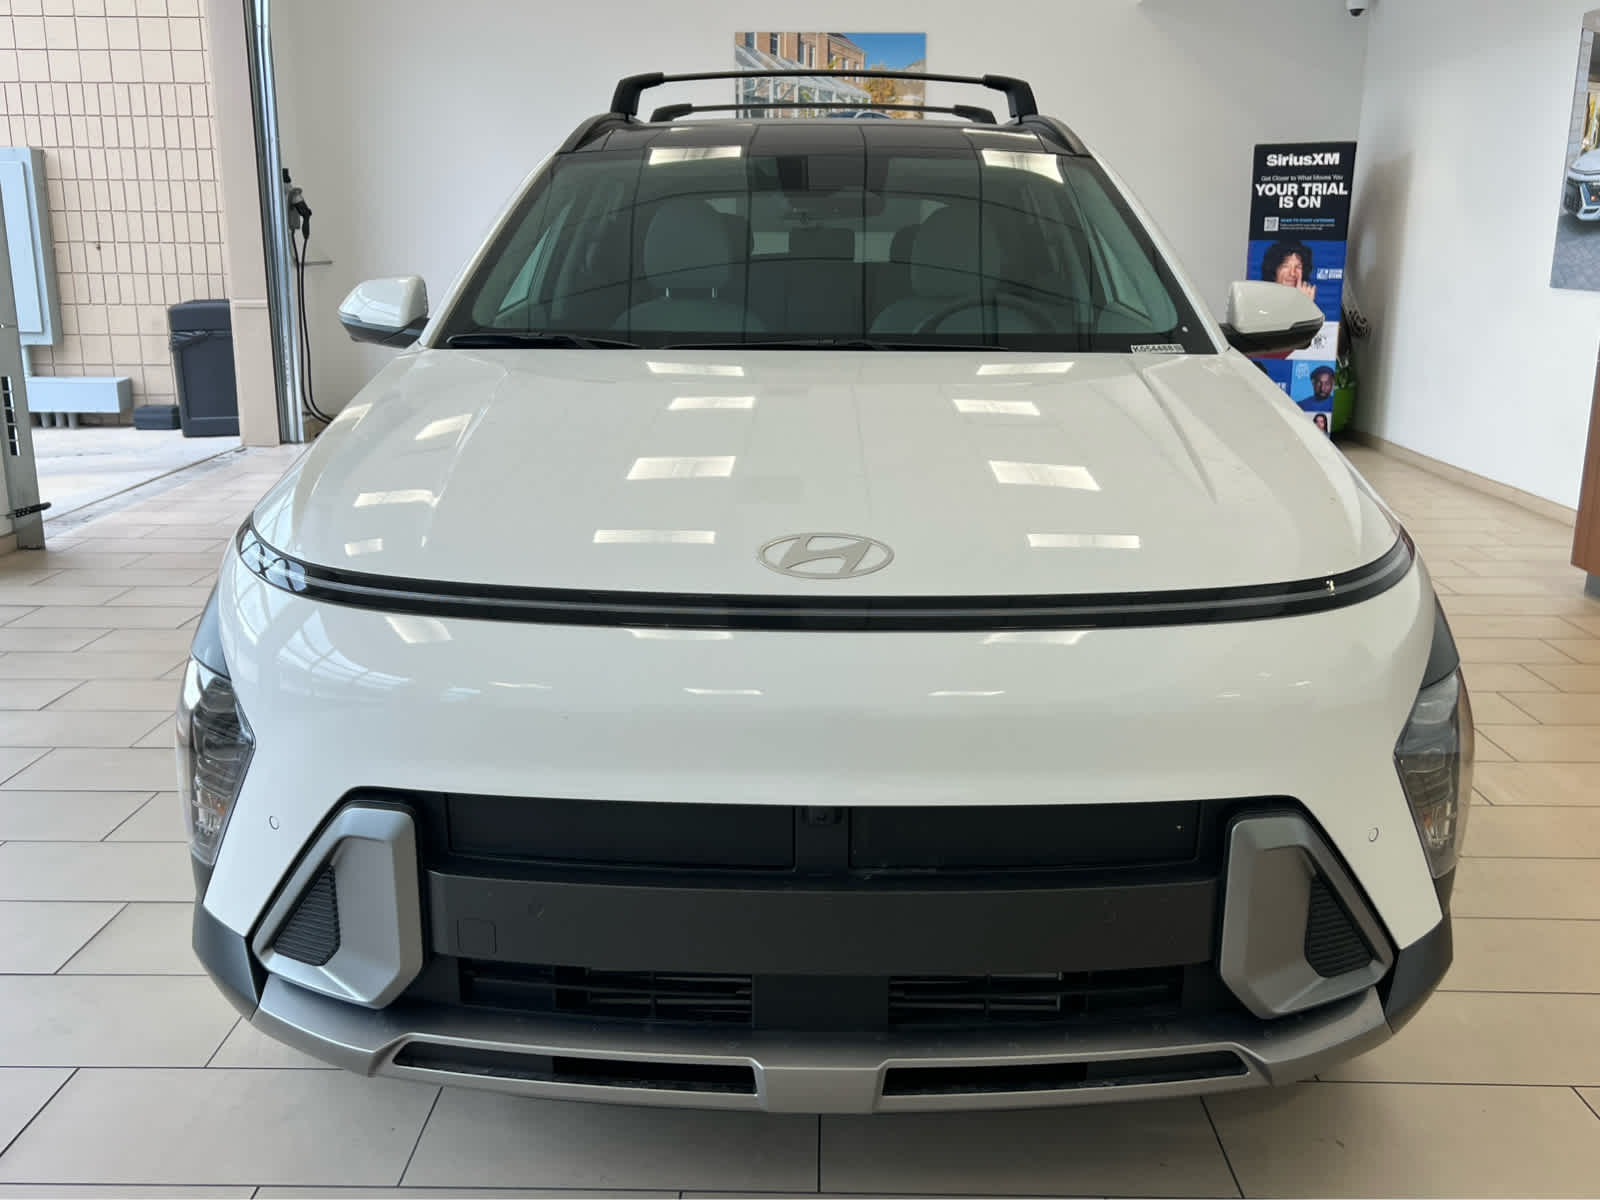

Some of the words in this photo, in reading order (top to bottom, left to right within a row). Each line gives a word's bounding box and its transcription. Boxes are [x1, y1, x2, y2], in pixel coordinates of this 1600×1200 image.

[1266, 152, 1340, 166] SiriusXM
[1255, 183, 1299, 196] YOUR
[1302, 182, 1348, 196] TRIAL
[1278, 196, 1294, 208] IS
[1297, 196, 1322, 208] ON
